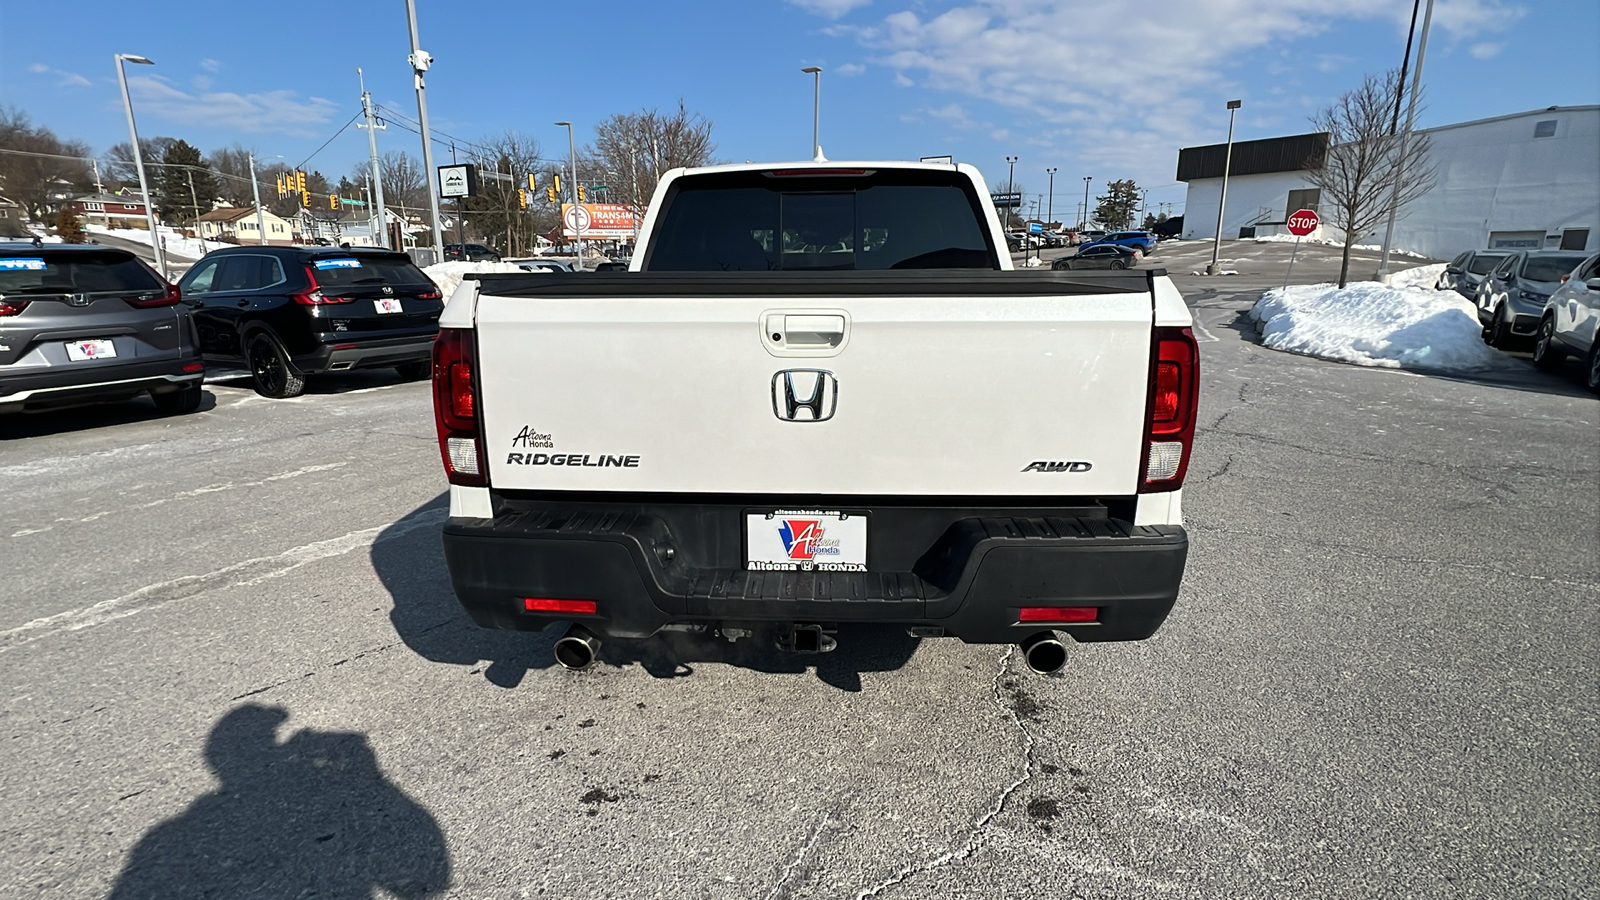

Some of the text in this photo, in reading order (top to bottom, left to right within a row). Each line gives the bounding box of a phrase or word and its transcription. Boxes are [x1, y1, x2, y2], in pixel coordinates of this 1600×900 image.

[592, 211, 634, 219] TRANS4M
[1289, 217, 1317, 229] STOP
[512, 425, 552, 448] Altoona
[529, 440, 554, 448] Honda
[506, 452, 641, 468] RIDGELINE
[1020, 461, 1093, 473] AWD
[788, 523, 840, 555] Altoona
[809, 546, 840, 555] Honda
[747, 561, 868, 572] Altoona HONDA
